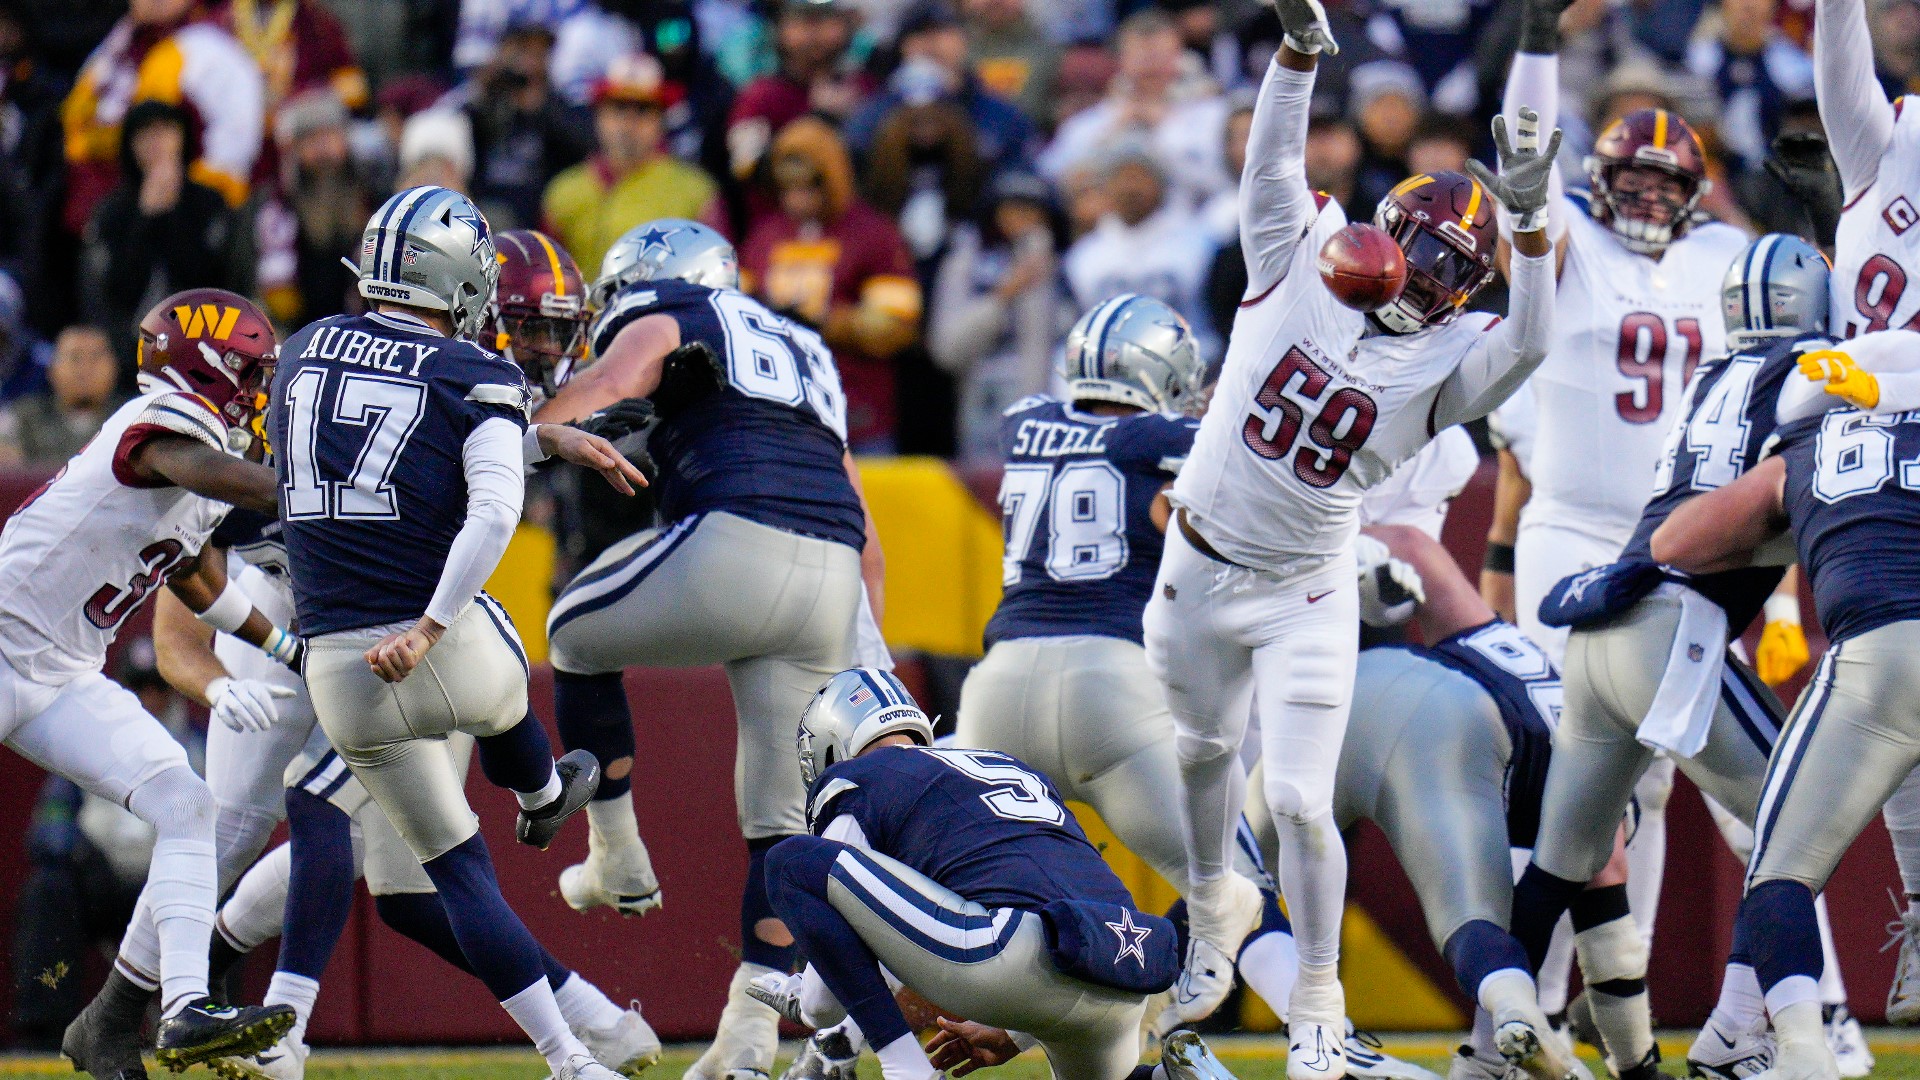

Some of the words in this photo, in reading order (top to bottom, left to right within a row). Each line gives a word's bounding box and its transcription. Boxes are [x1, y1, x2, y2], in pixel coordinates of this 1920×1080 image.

[174, 304, 241, 340] W
[367, 284, 410, 299] COWBOYS
[1845, 253, 1920, 341] 9
[300, 327, 439, 377] AUBREY
[708, 289, 848, 444] 63
[1302, 337, 1385, 394] WASHINGTON
[1615, 312, 1703, 424] 91
[284, 366, 428, 521] 17
[1012, 418, 1119, 458] STEELE
[1242, 344, 1378, 489] 59
[998, 460, 1129, 587] 78
[83, 538, 198, 630] 3
[919, 747, 1066, 827] 5
